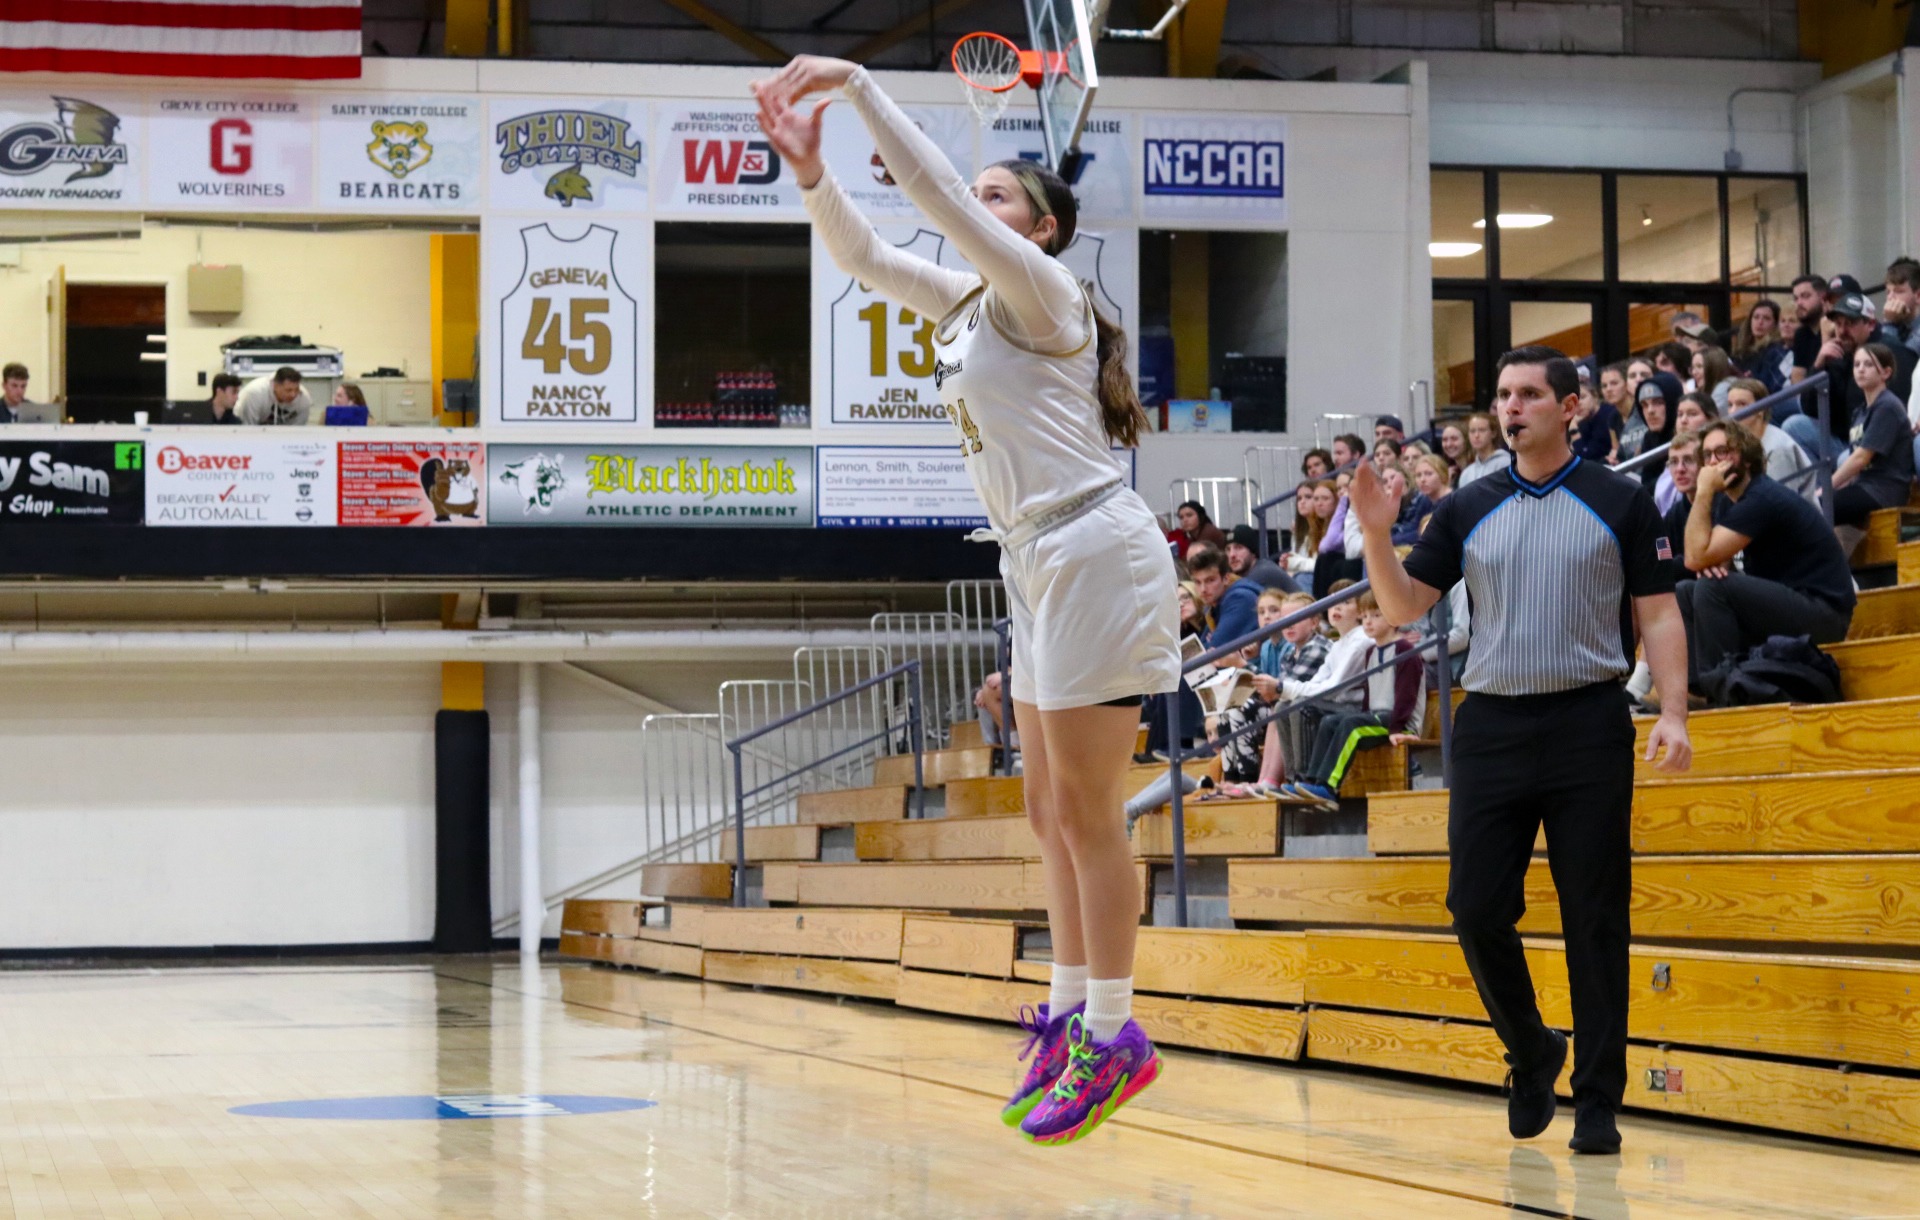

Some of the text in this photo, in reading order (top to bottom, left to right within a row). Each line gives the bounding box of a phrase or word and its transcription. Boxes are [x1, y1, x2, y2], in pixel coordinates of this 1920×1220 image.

[161, 101, 299, 113] GROVE CITY COLLEGE
[332, 105, 467, 117] SAINT VINCENT COLLEGE
[690, 112, 758, 122] WASHINGTO
[671, 122, 738, 132] JEFFERSON
[1083, 119, 1121, 133] OLLEGE
[496, 110, 641, 163] THIEL
[0, 122, 128, 176] GENEVA
[210, 118, 253, 175] G
[502, 145, 637, 177] COLLEGE
[1146, 140, 1282, 187] NCCAA
[48, 188, 121, 199] TORNADOES
[178, 182, 285, 196] WOLVERINES
[340, 182, 460, 199] BEARCATS
[688, 193, 779, 206] PRESIDENTS
[530, 267, 608, 290] GENEVA
[521, 297, 612, 375] 45
[858, 302, 936, 378] 13
[532, 385, 606, 400] NANCY
[879, 389, 918, 403] JEN
[527, 402, 611, 416] PAXTON
[850, 404, 948, 419] RAWDING
[157, 446, 252, 474] Beaver
[29, 451, 110, 497] Sam
[290, 468, 319, 479] Jeep
[825, 461, 966, 474] Lennon, Smith, Souleret
[188, 472, 274, 480] COUNTY AUTO
[586, 454, 797, 500] Blackhawk
[826, 476, 947, 486] Civil Engineers and Surveyors
[9, 494, 53, 517] Shop
[157, 494, 214, 504] BEAVER
[159, 507, 267, 520] AUTOMALL
[586, 505, 798, 517] ATHLETIC DEPARTMENT
[822, 518, 989, 526] CIVIL SITE WATER WASTEWAT
